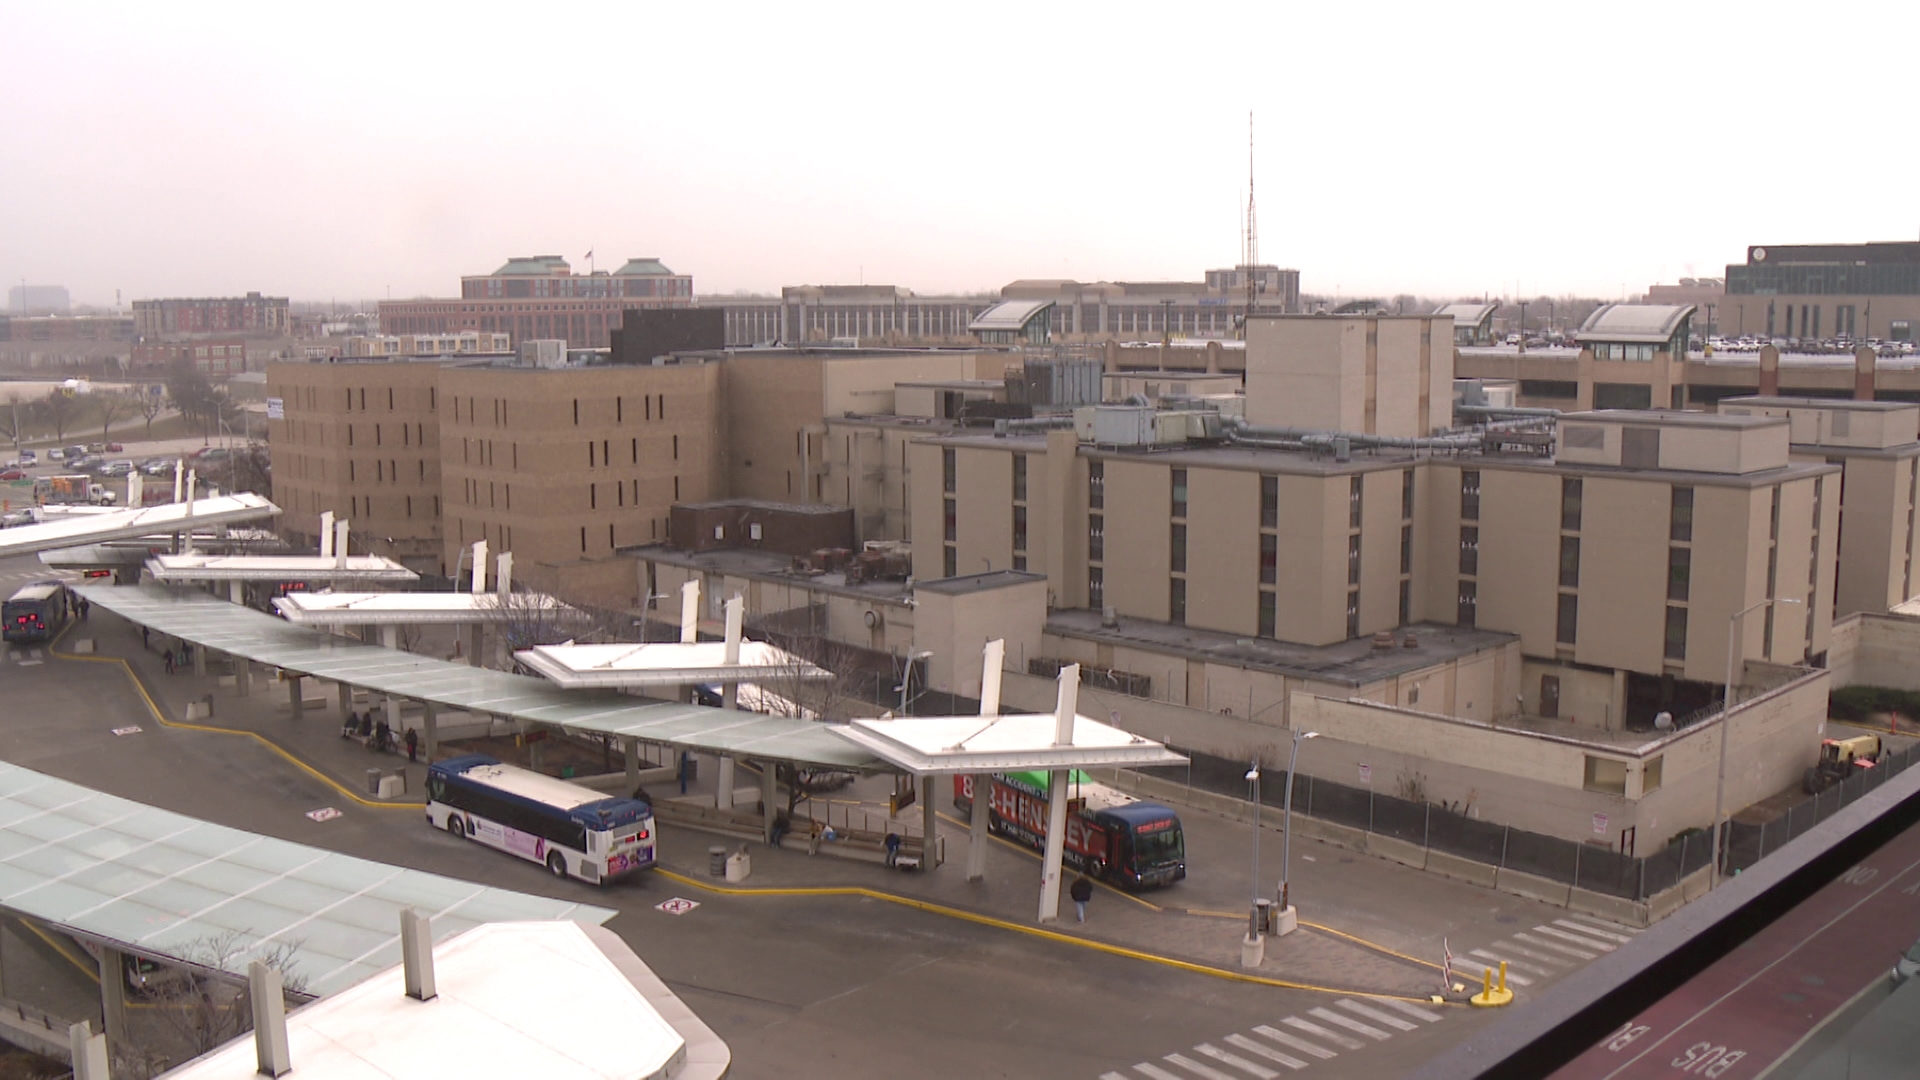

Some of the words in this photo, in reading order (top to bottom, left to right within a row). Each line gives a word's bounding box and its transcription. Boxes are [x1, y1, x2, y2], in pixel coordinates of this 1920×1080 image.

[1006, 776, 1036, 795] ACCIDENT
[1600, 1022, 1651, 1052] BU
[1671, 1041, 1747, 1079] BUS
